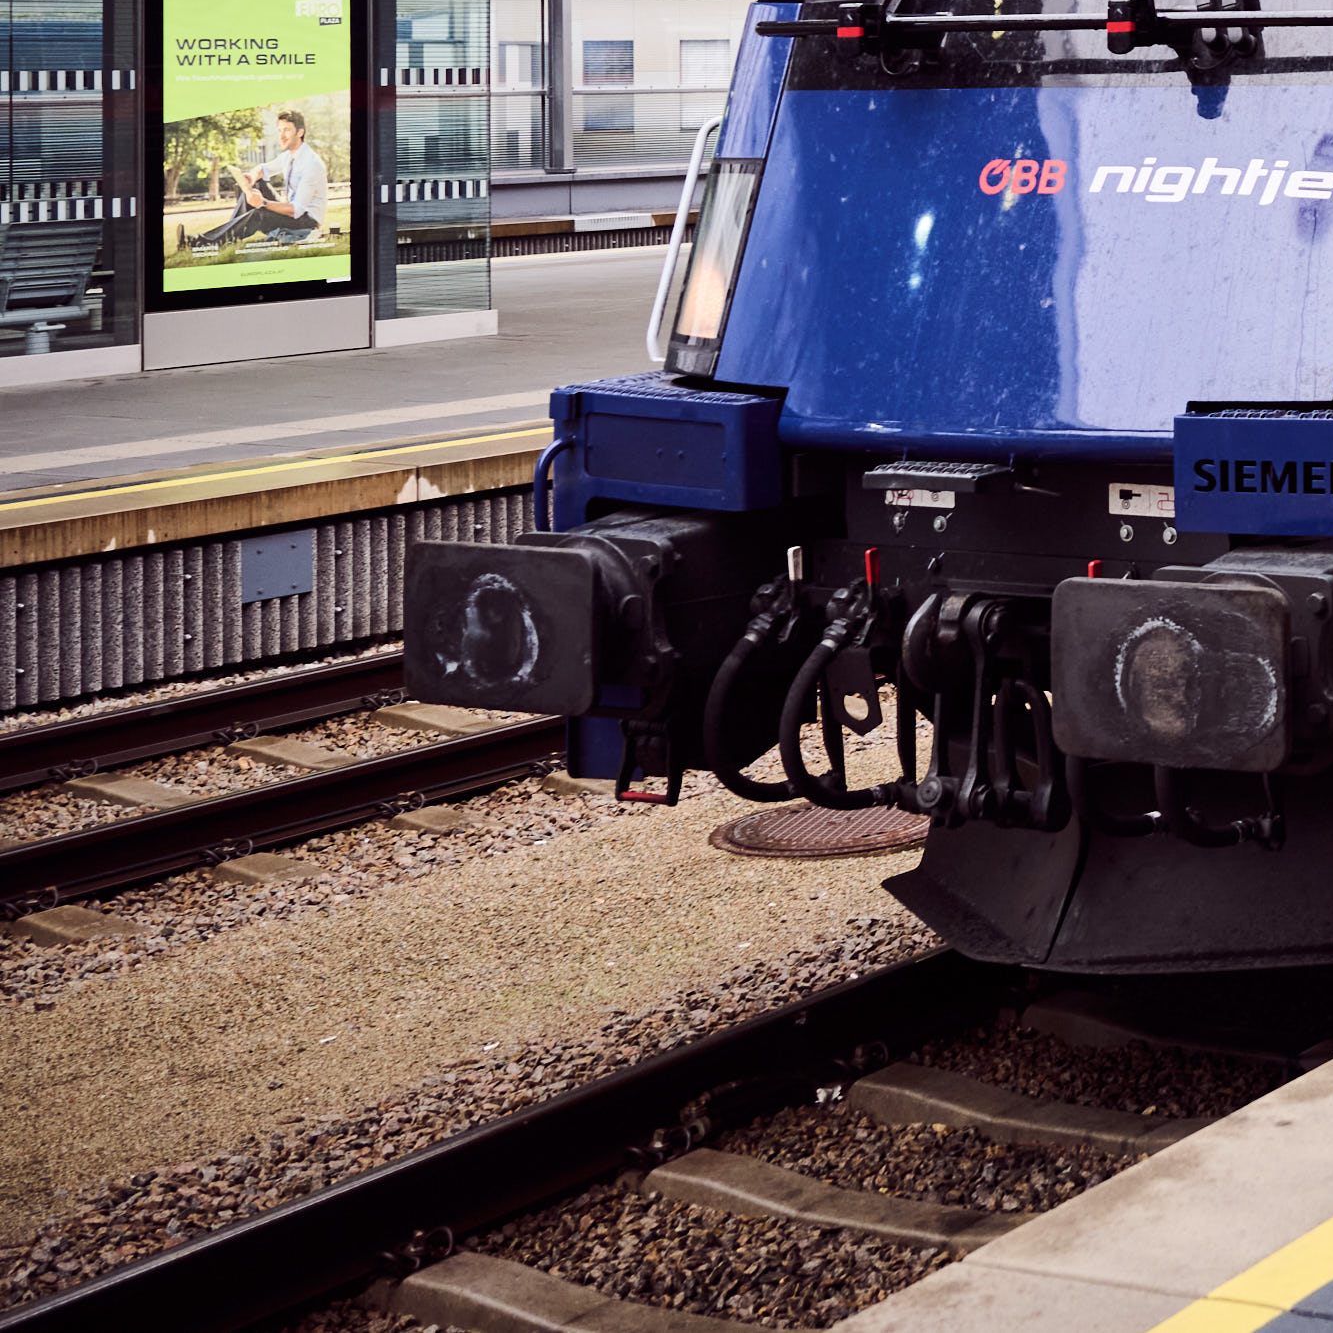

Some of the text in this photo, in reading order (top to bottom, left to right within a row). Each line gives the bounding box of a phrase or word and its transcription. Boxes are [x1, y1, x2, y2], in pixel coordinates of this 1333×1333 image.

[300, 2, 341, 17] EURO
[320, 17, 340, 25] PLAZA
[176, 38, 279, 50] WORKING
[176, 53, 316, 66] WITH A SMILE
[979, 158, 1068, 196] ÖBB
